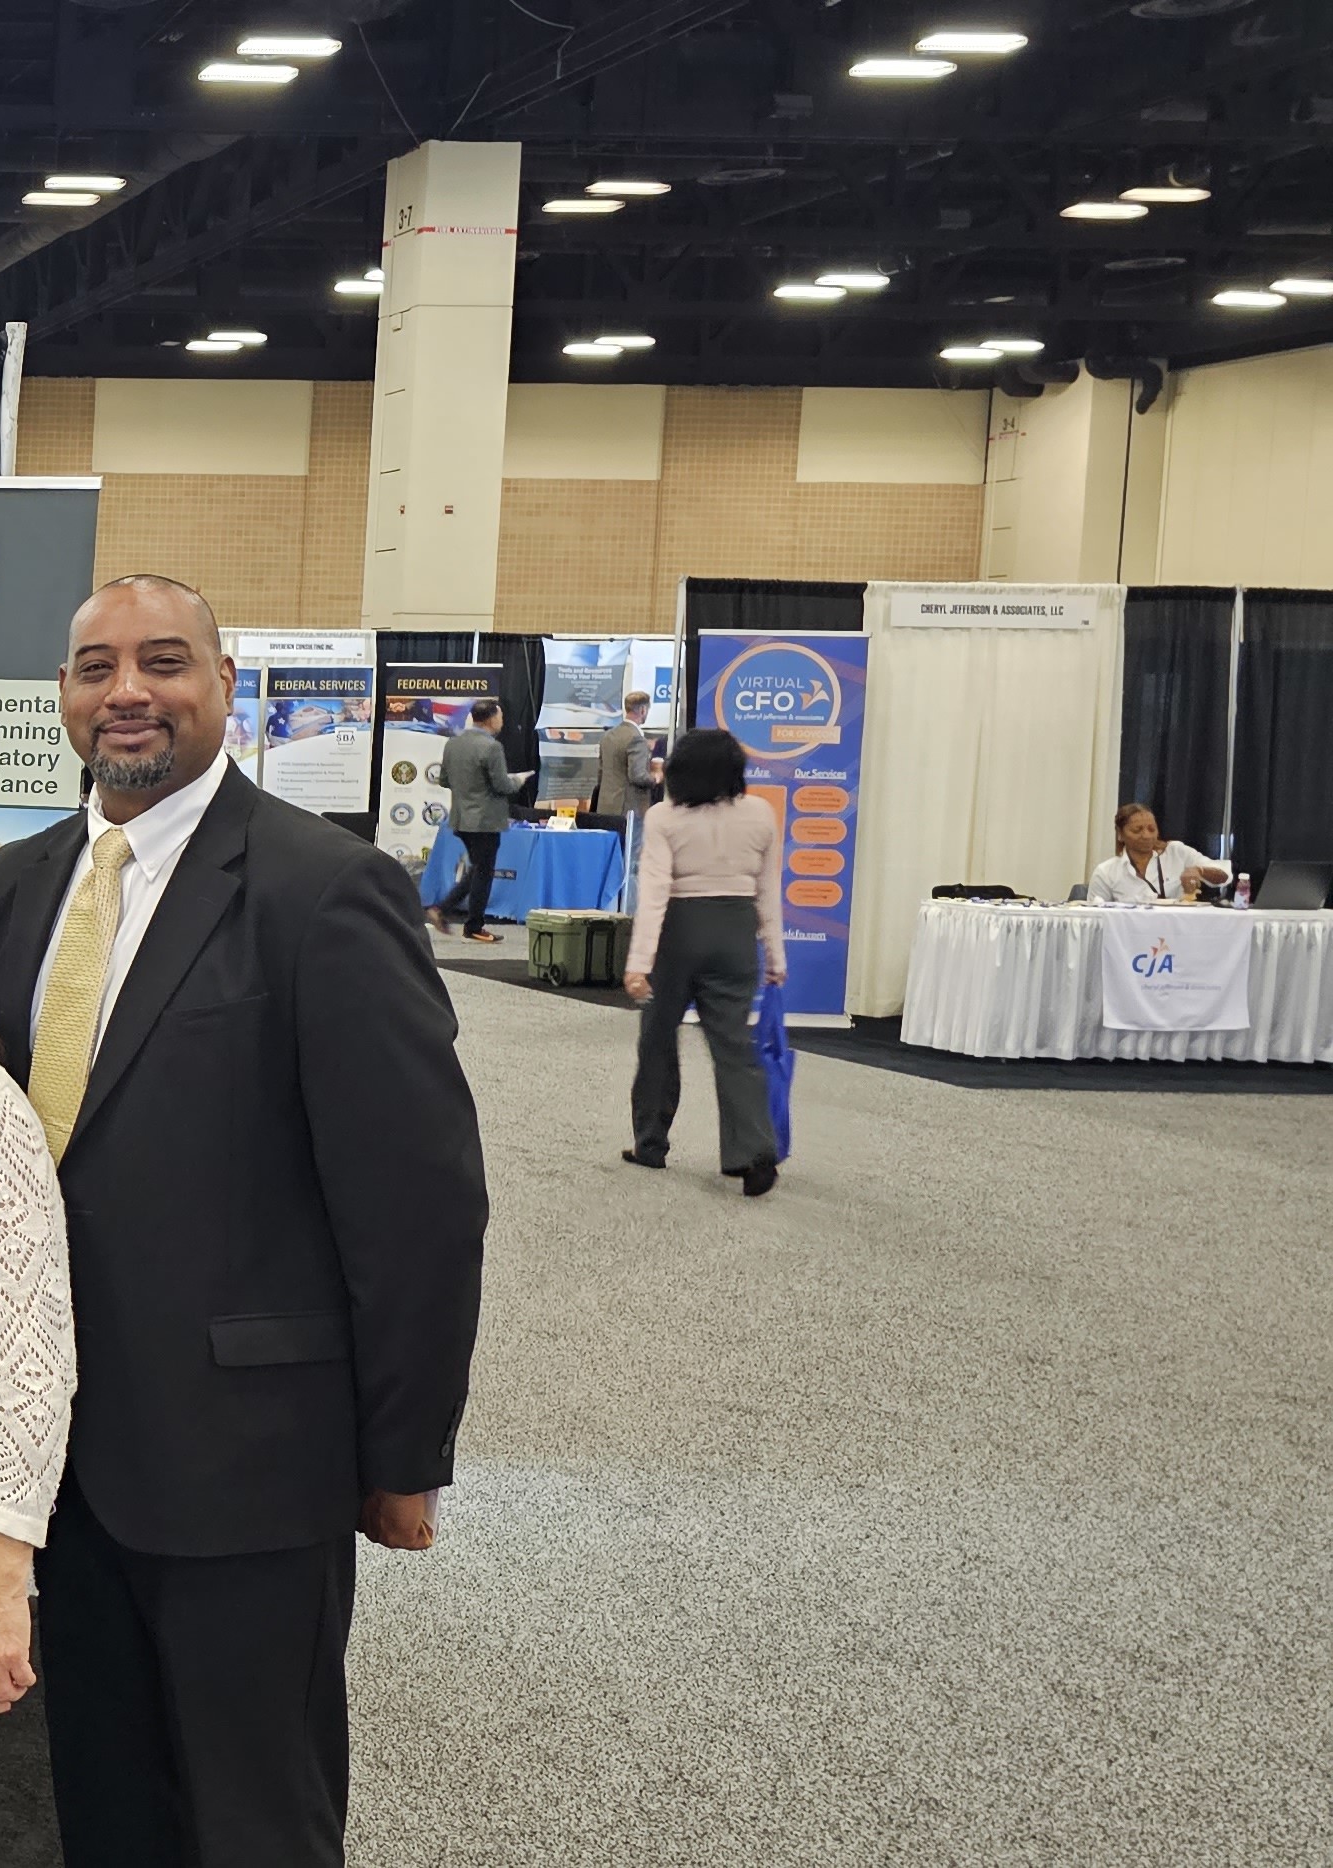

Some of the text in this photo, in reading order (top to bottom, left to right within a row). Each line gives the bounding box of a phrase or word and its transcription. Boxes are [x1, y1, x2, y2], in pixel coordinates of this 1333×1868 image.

[275, 680, 365, 690] FEDERAL SERVICES
[397, 679, 487, 691] FEDERAL CLIENTS
[737, 677, 805, 688] VIRTUAL
[735, 691, 794, 711] CFO
